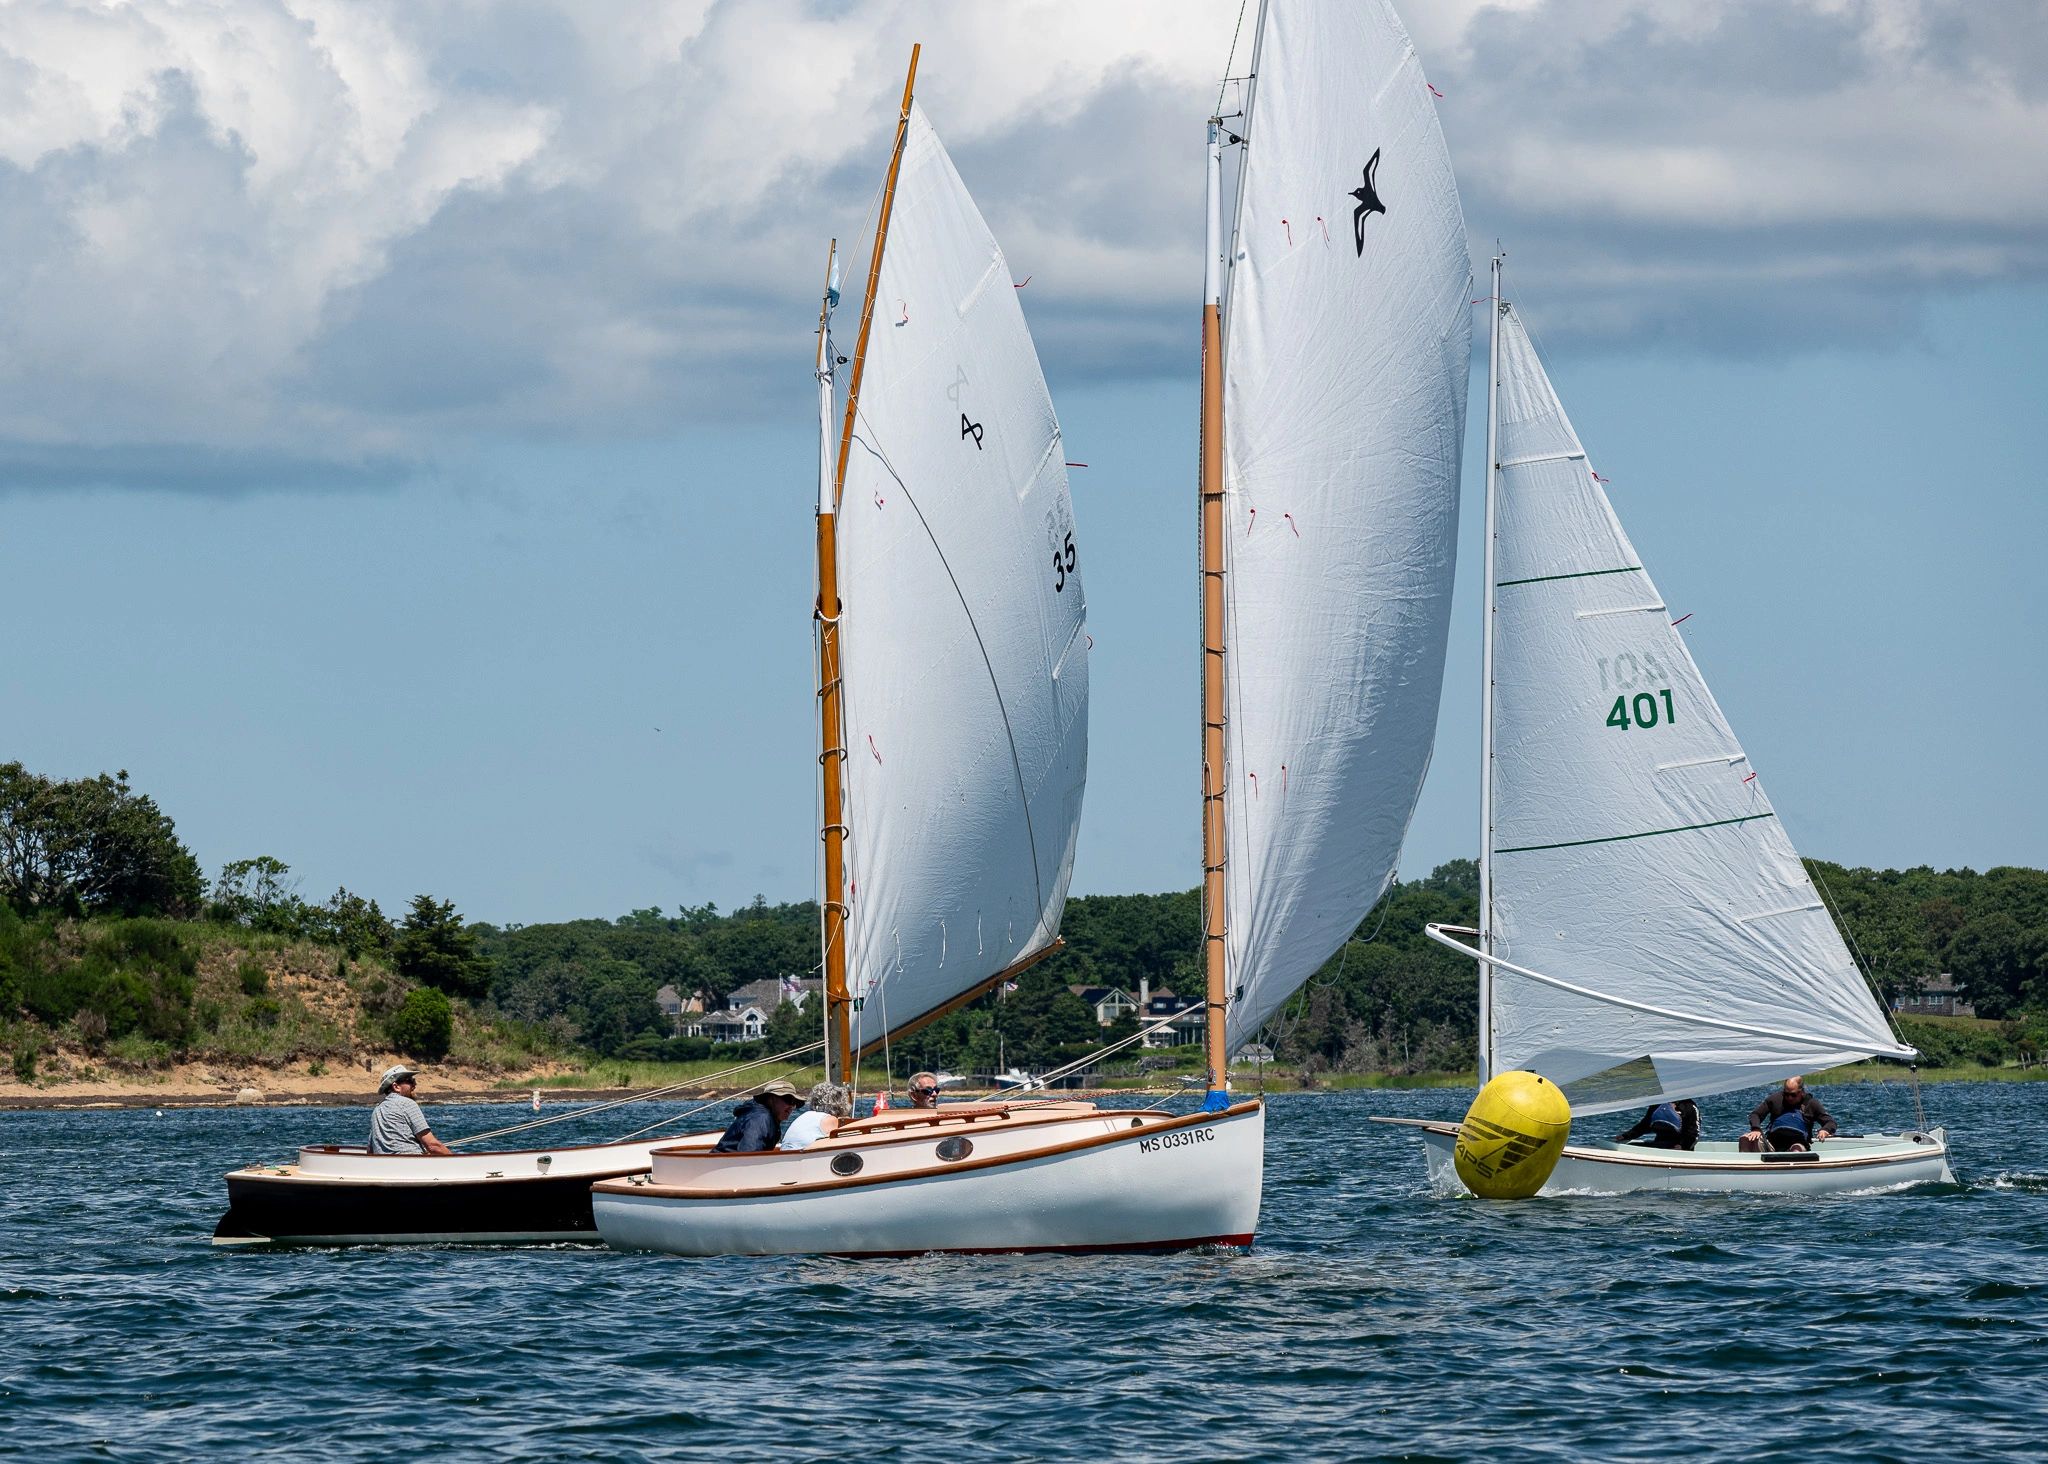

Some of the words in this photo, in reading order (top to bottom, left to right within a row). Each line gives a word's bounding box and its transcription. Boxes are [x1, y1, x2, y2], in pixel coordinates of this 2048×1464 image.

[1053, 531, 1076, 593] 35
[1606, 689, 1675, 731] 401
[1140, 1137, 1161, 1154] MS
[1456, 1143, 1494, 1180] APS
